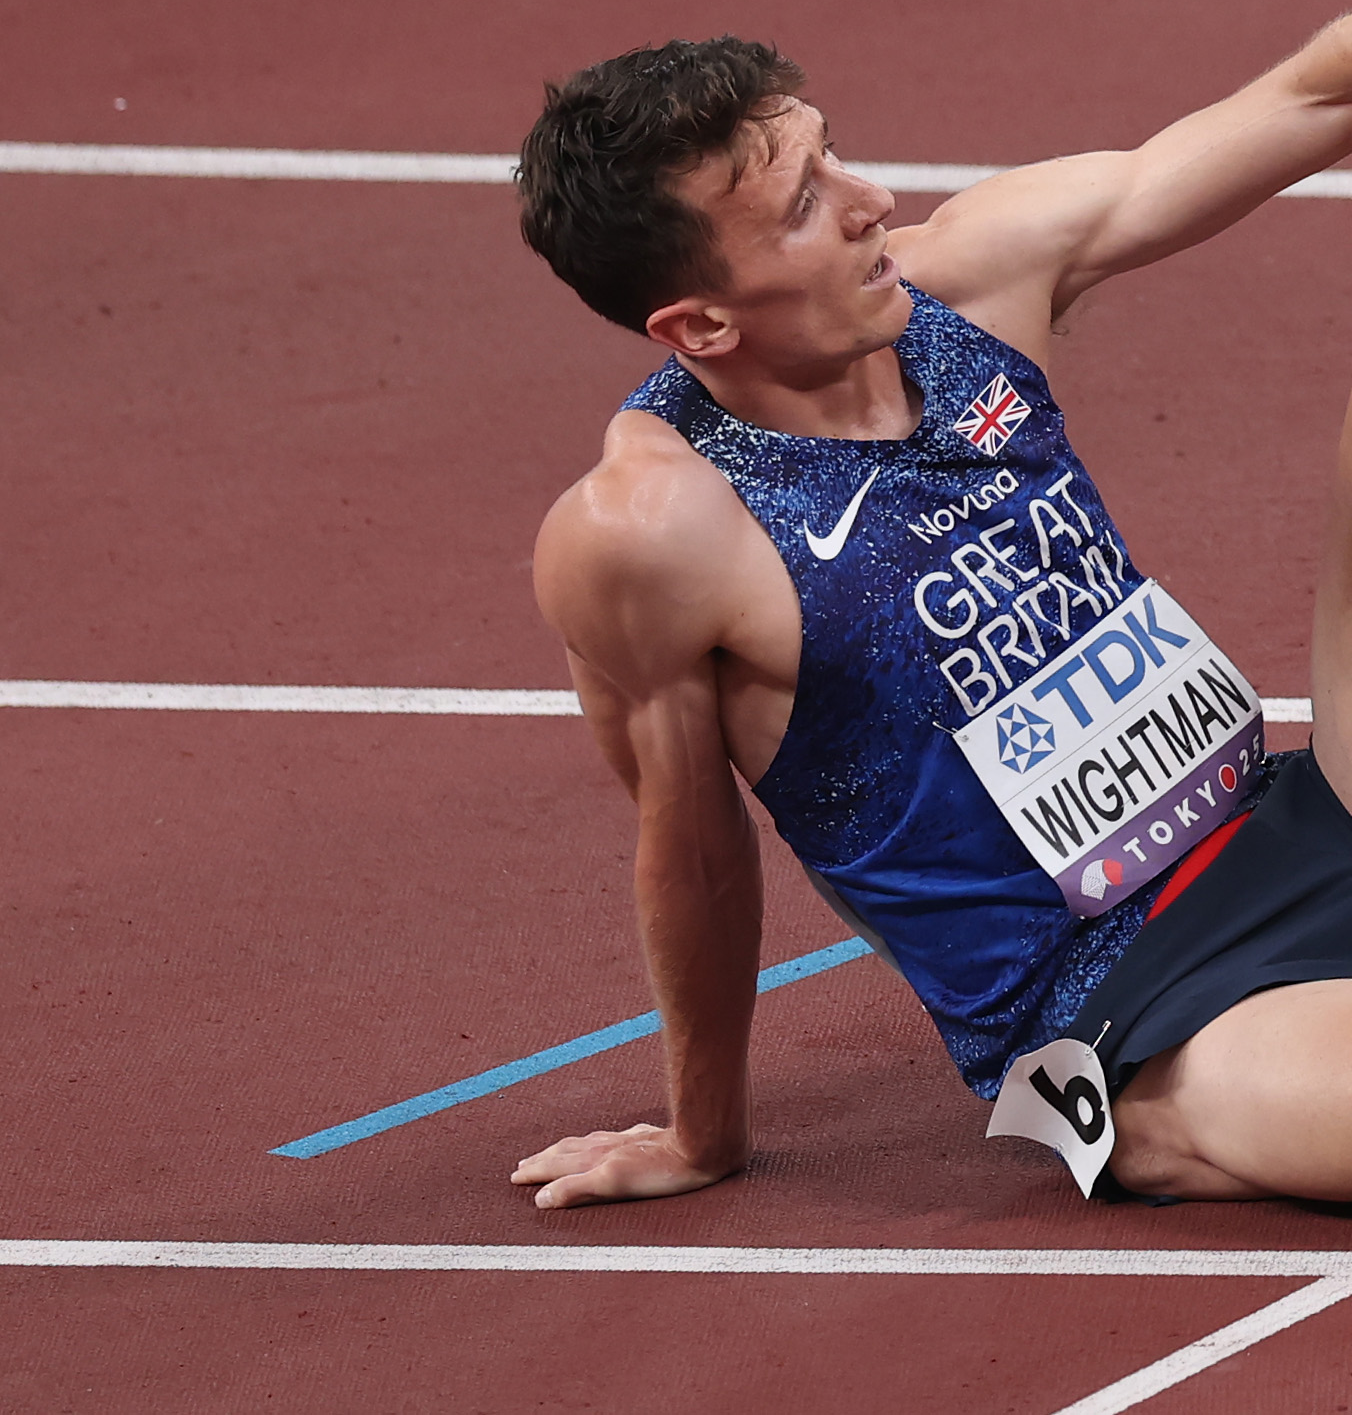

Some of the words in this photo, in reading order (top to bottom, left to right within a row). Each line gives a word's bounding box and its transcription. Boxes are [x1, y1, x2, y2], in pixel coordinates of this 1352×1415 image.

[908, 468, 1020, 544] Novuna
[914, 471, 1093, 639] GREAT
[940, 530, 1125, 717] BRITAIN
[1031, 593, 1190, 730] TDK
[1020, 658, 1252, 860] WIGHTMAN
[1239, 734, 1259, 776] 25
